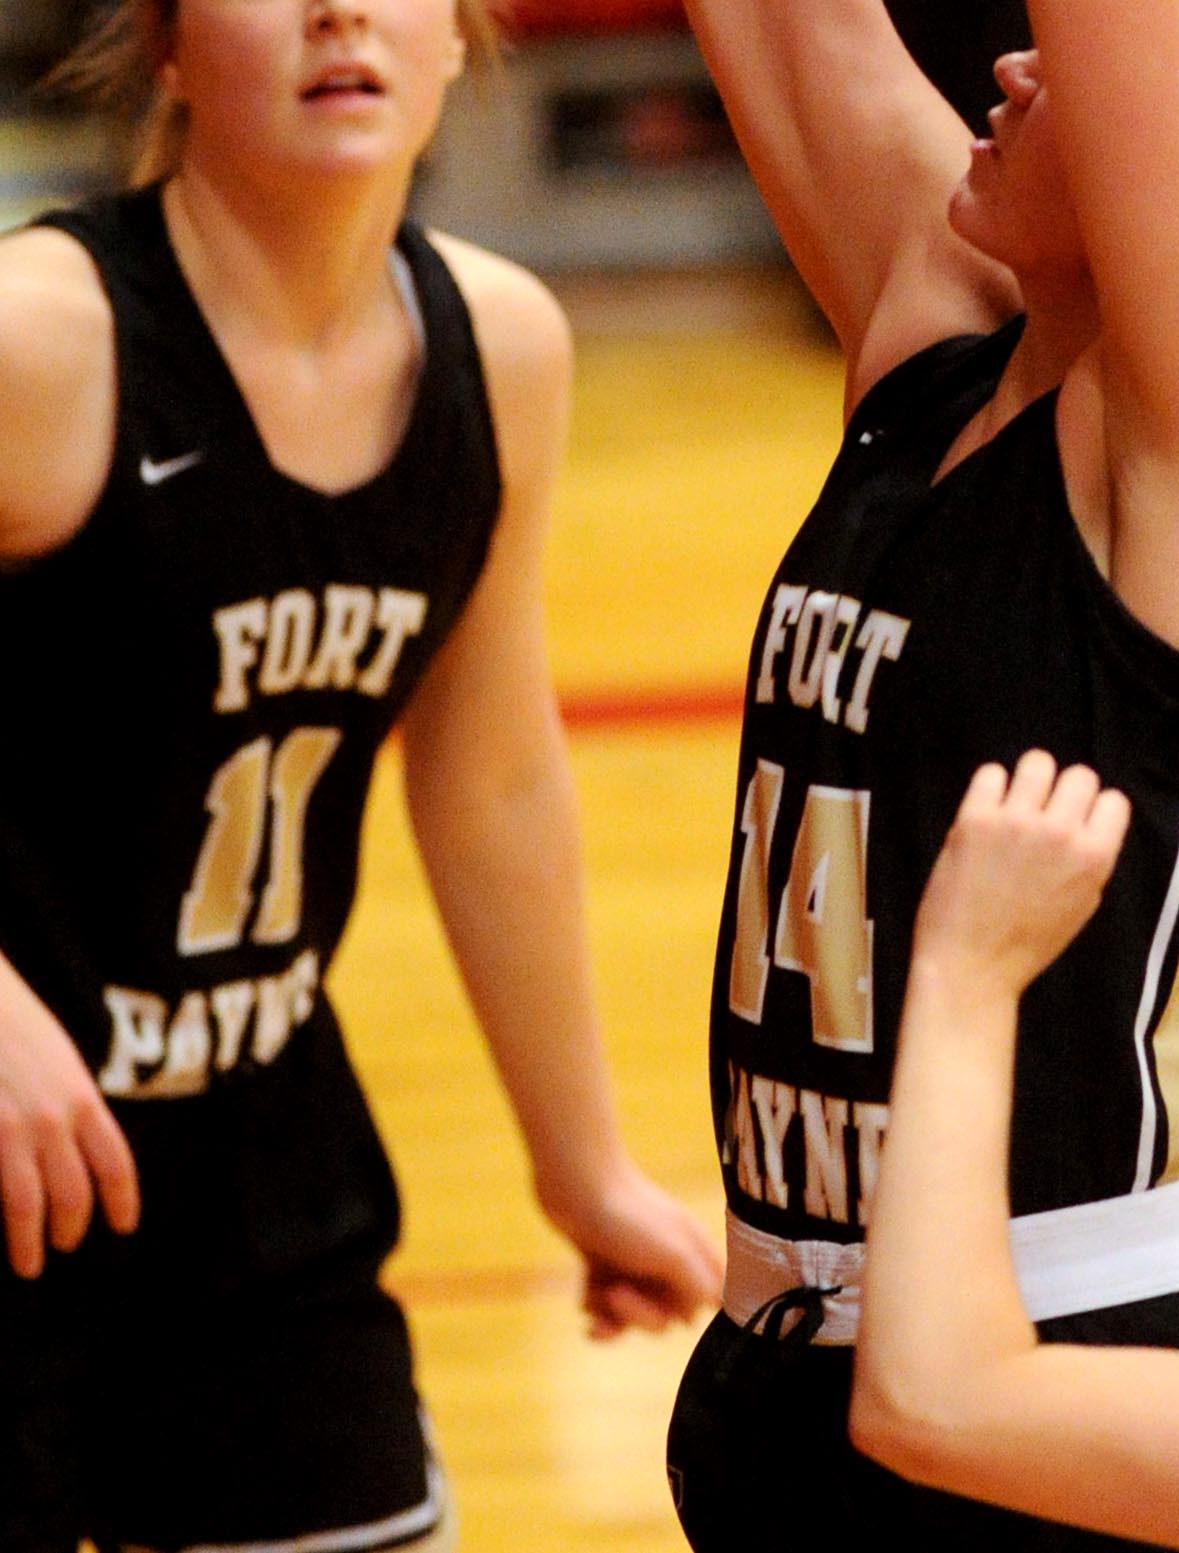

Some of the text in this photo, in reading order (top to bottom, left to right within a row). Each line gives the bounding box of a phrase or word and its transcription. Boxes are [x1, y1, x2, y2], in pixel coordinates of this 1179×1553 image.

[211, 583, 429, 714] FORT
[755, 582, 912, 736] FORT
[176, 726, 343, 957] 11
[727, 758, 875, 1054] 14
[98, 948, 319, 1100] PAYN
